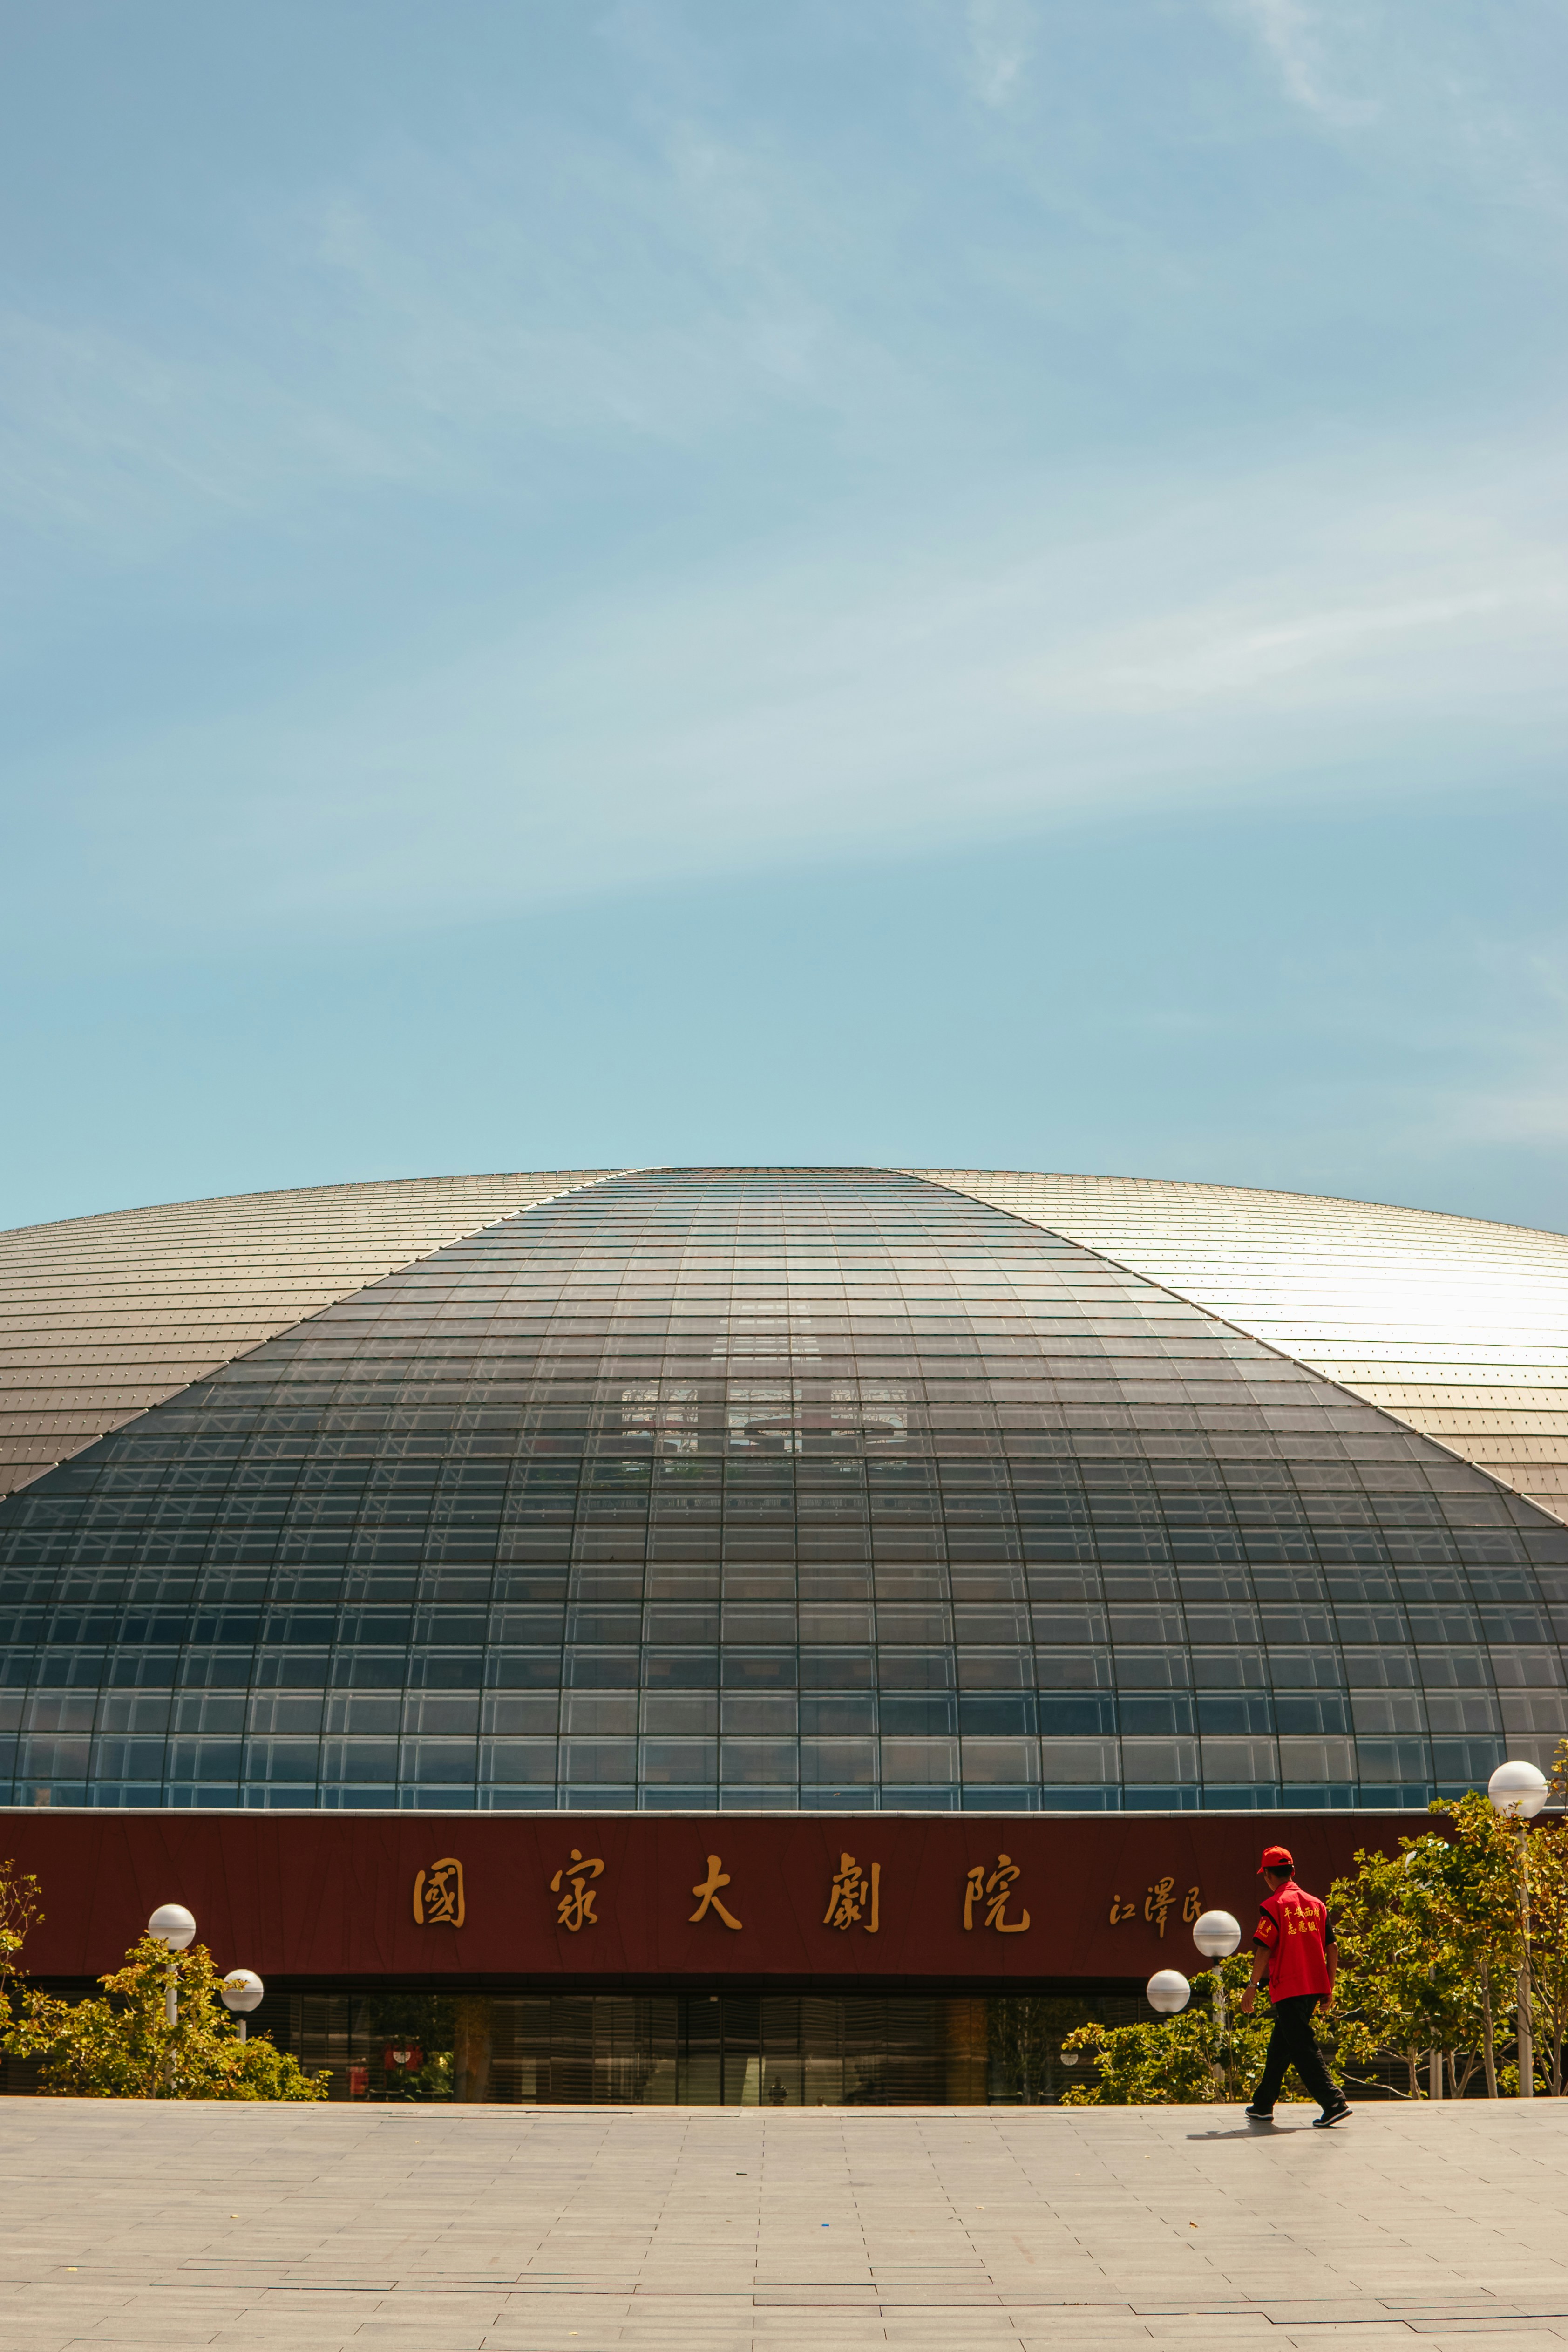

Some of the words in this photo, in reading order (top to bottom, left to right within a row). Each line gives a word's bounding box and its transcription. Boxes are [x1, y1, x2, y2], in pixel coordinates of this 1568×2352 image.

[413, 1849, 1030, 1933] 國家大劇院
[1288, 1920, 1319, 1935] 志愿服
